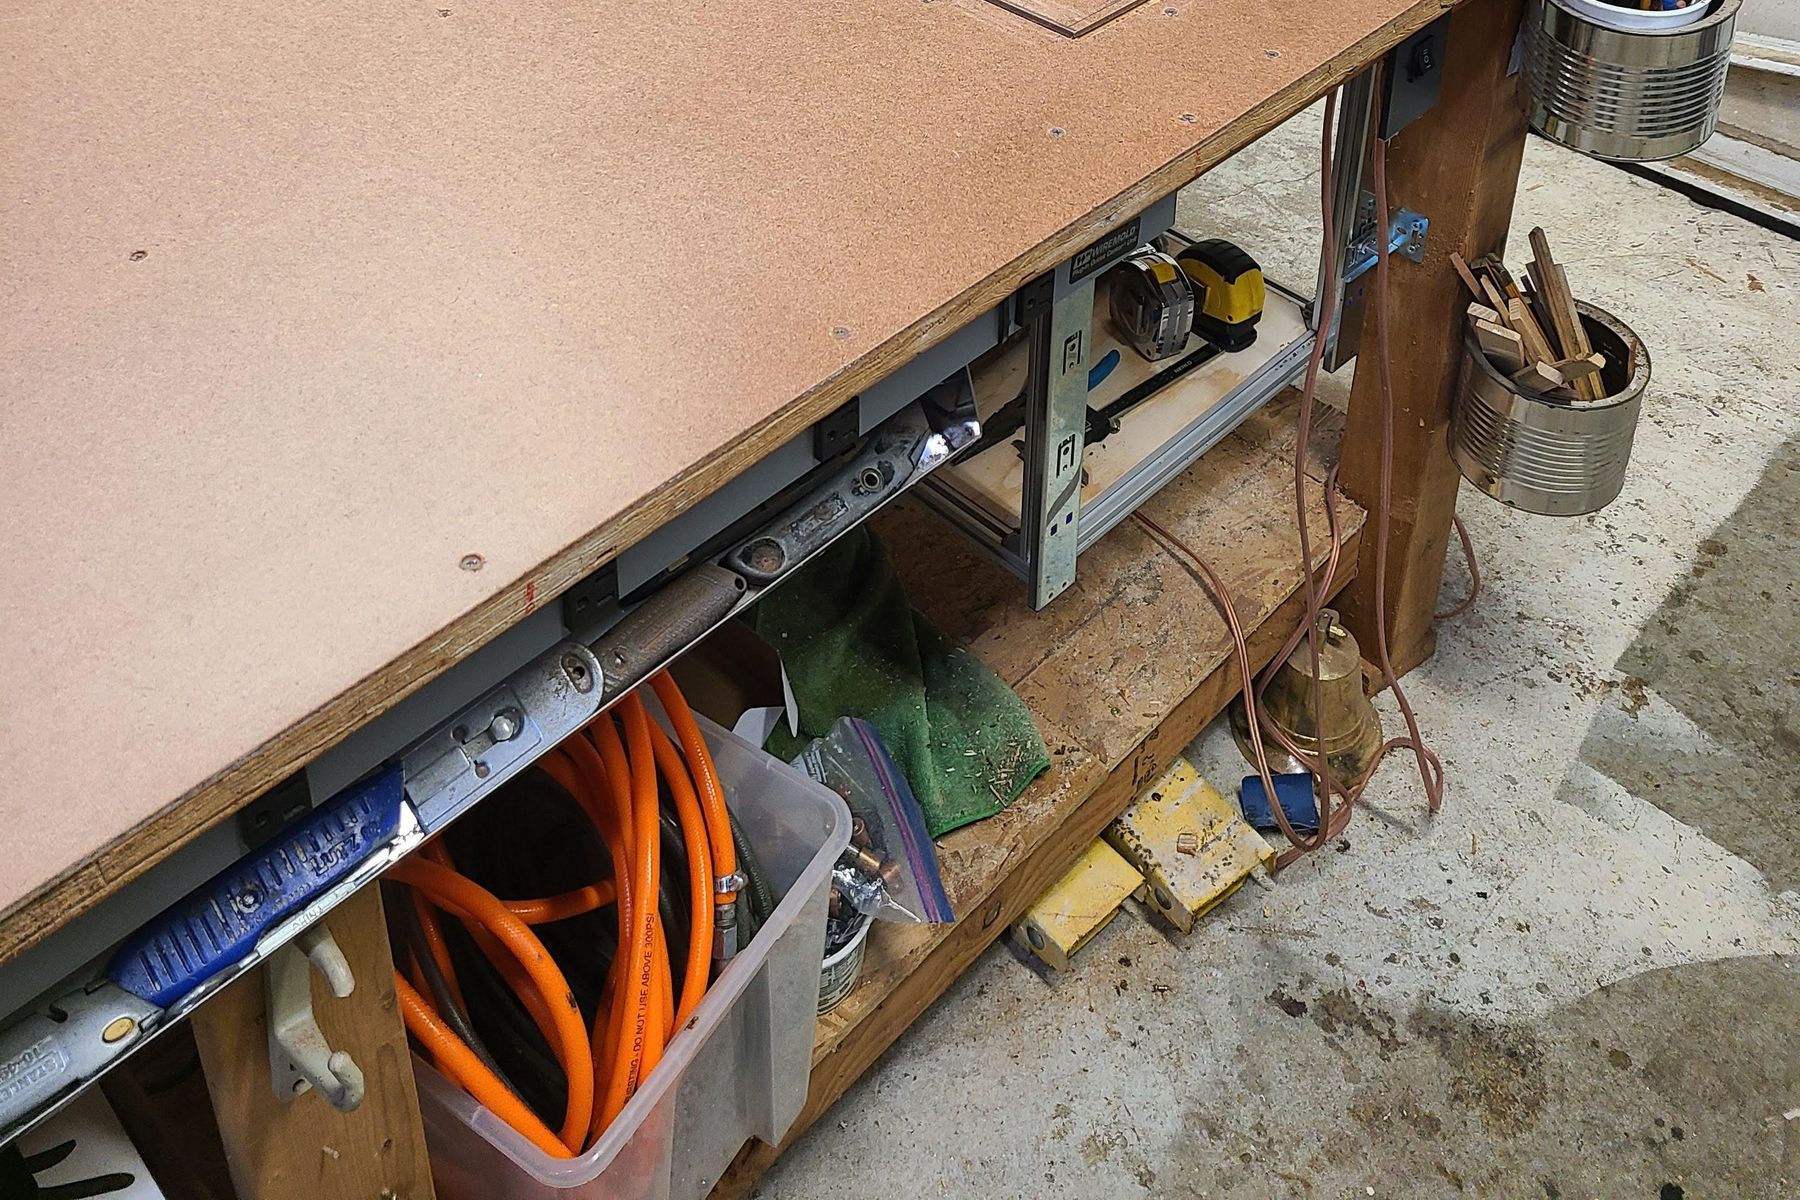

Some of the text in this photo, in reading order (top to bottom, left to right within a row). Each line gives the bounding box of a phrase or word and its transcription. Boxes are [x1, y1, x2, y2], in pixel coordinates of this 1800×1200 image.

[310, 833, 361, 877] LUTZ
[641, 951, 653, 987] ABOVE
[638, 989, 649, 1011] USE
[636, 1011, 647, 1036] NOT
[633, 1037, 643, 1053] DO
